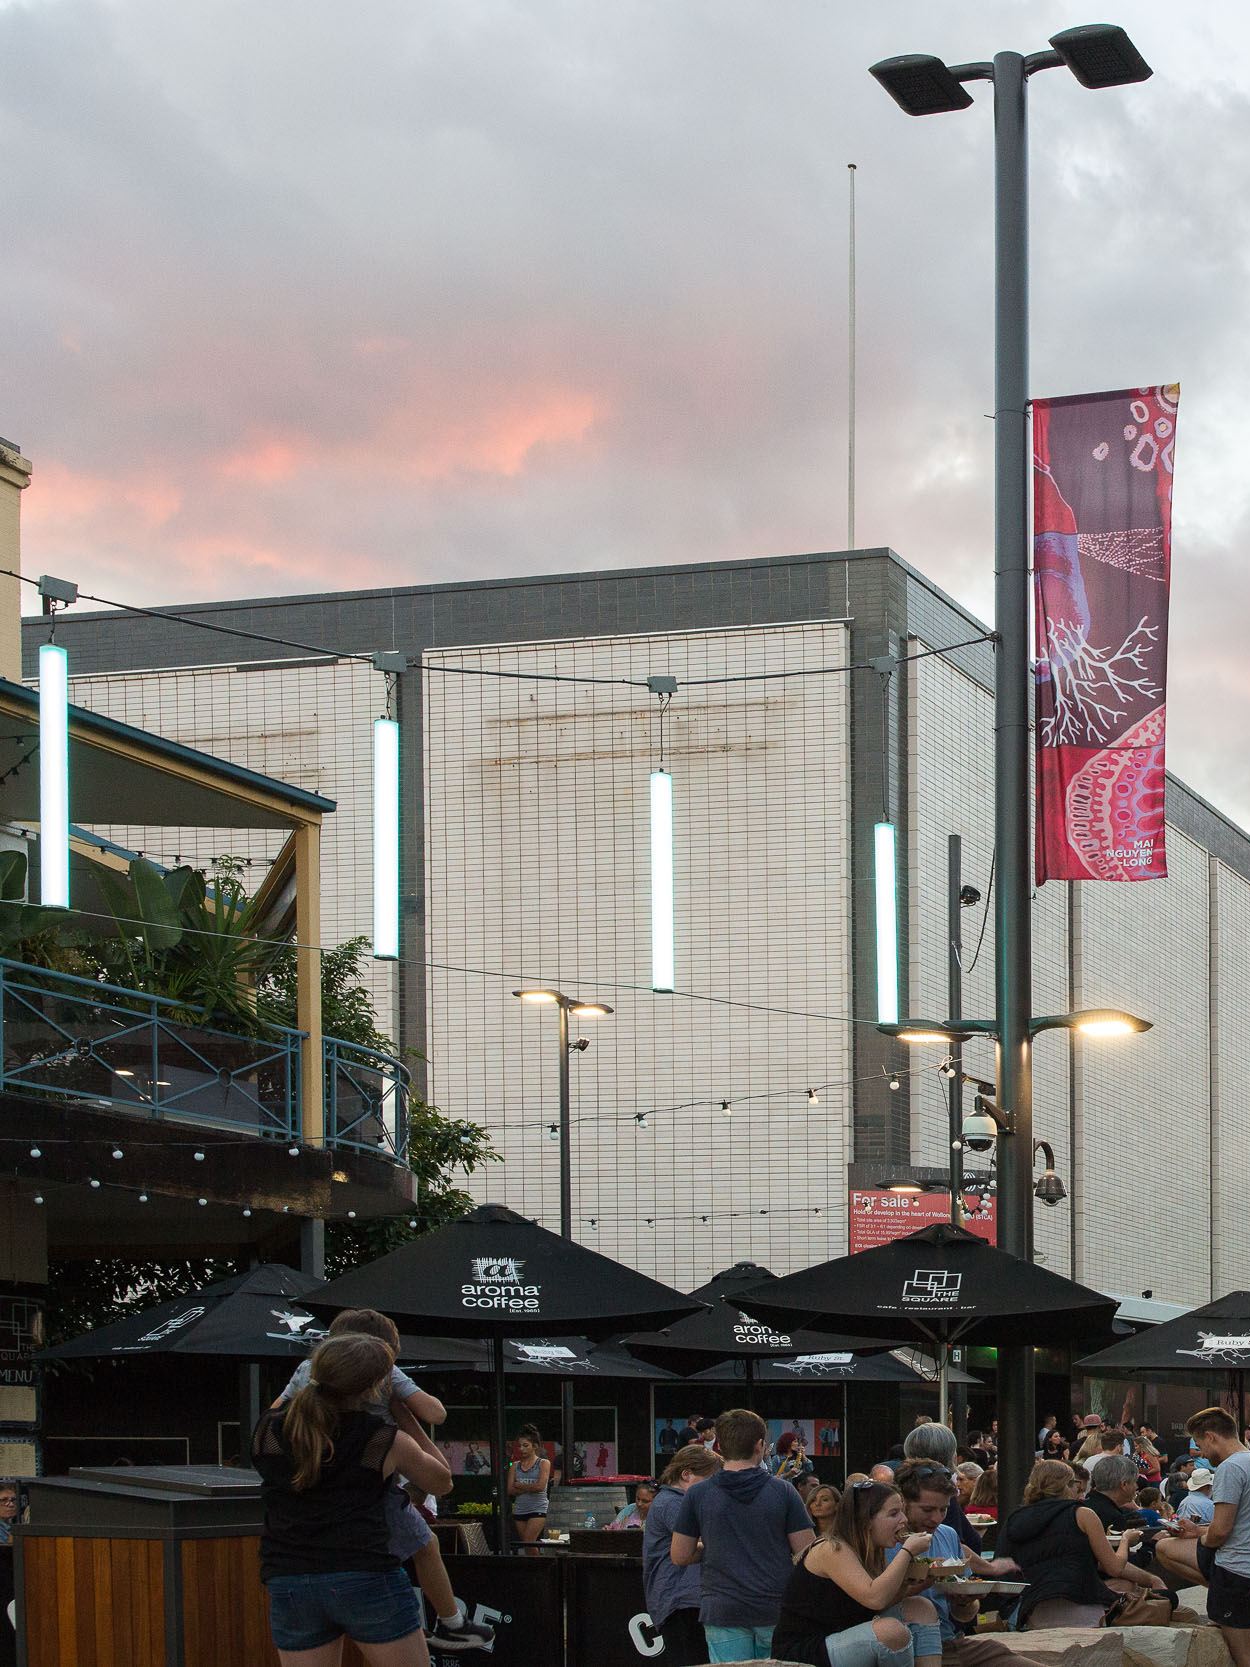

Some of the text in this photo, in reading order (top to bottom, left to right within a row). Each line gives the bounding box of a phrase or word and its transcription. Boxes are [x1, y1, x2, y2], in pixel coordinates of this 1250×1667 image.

[1133, 839, 1154, 849] MAI
[1106, 848, 1153, 858] NGUYEN
[1119, 857, 1152, 867] -LONG
[853, 1192, 910, 1208] For sale
[873, 1209, 895, 1218] develop
[910, 1210, 925, 1218] heart
[932, 1211, 951, 1219] Wollon
[461, 1284, 540, 1296] aroma
[462, 1297, 539, 1309] coffee
[735, 1335, 791, 1345] coffee
